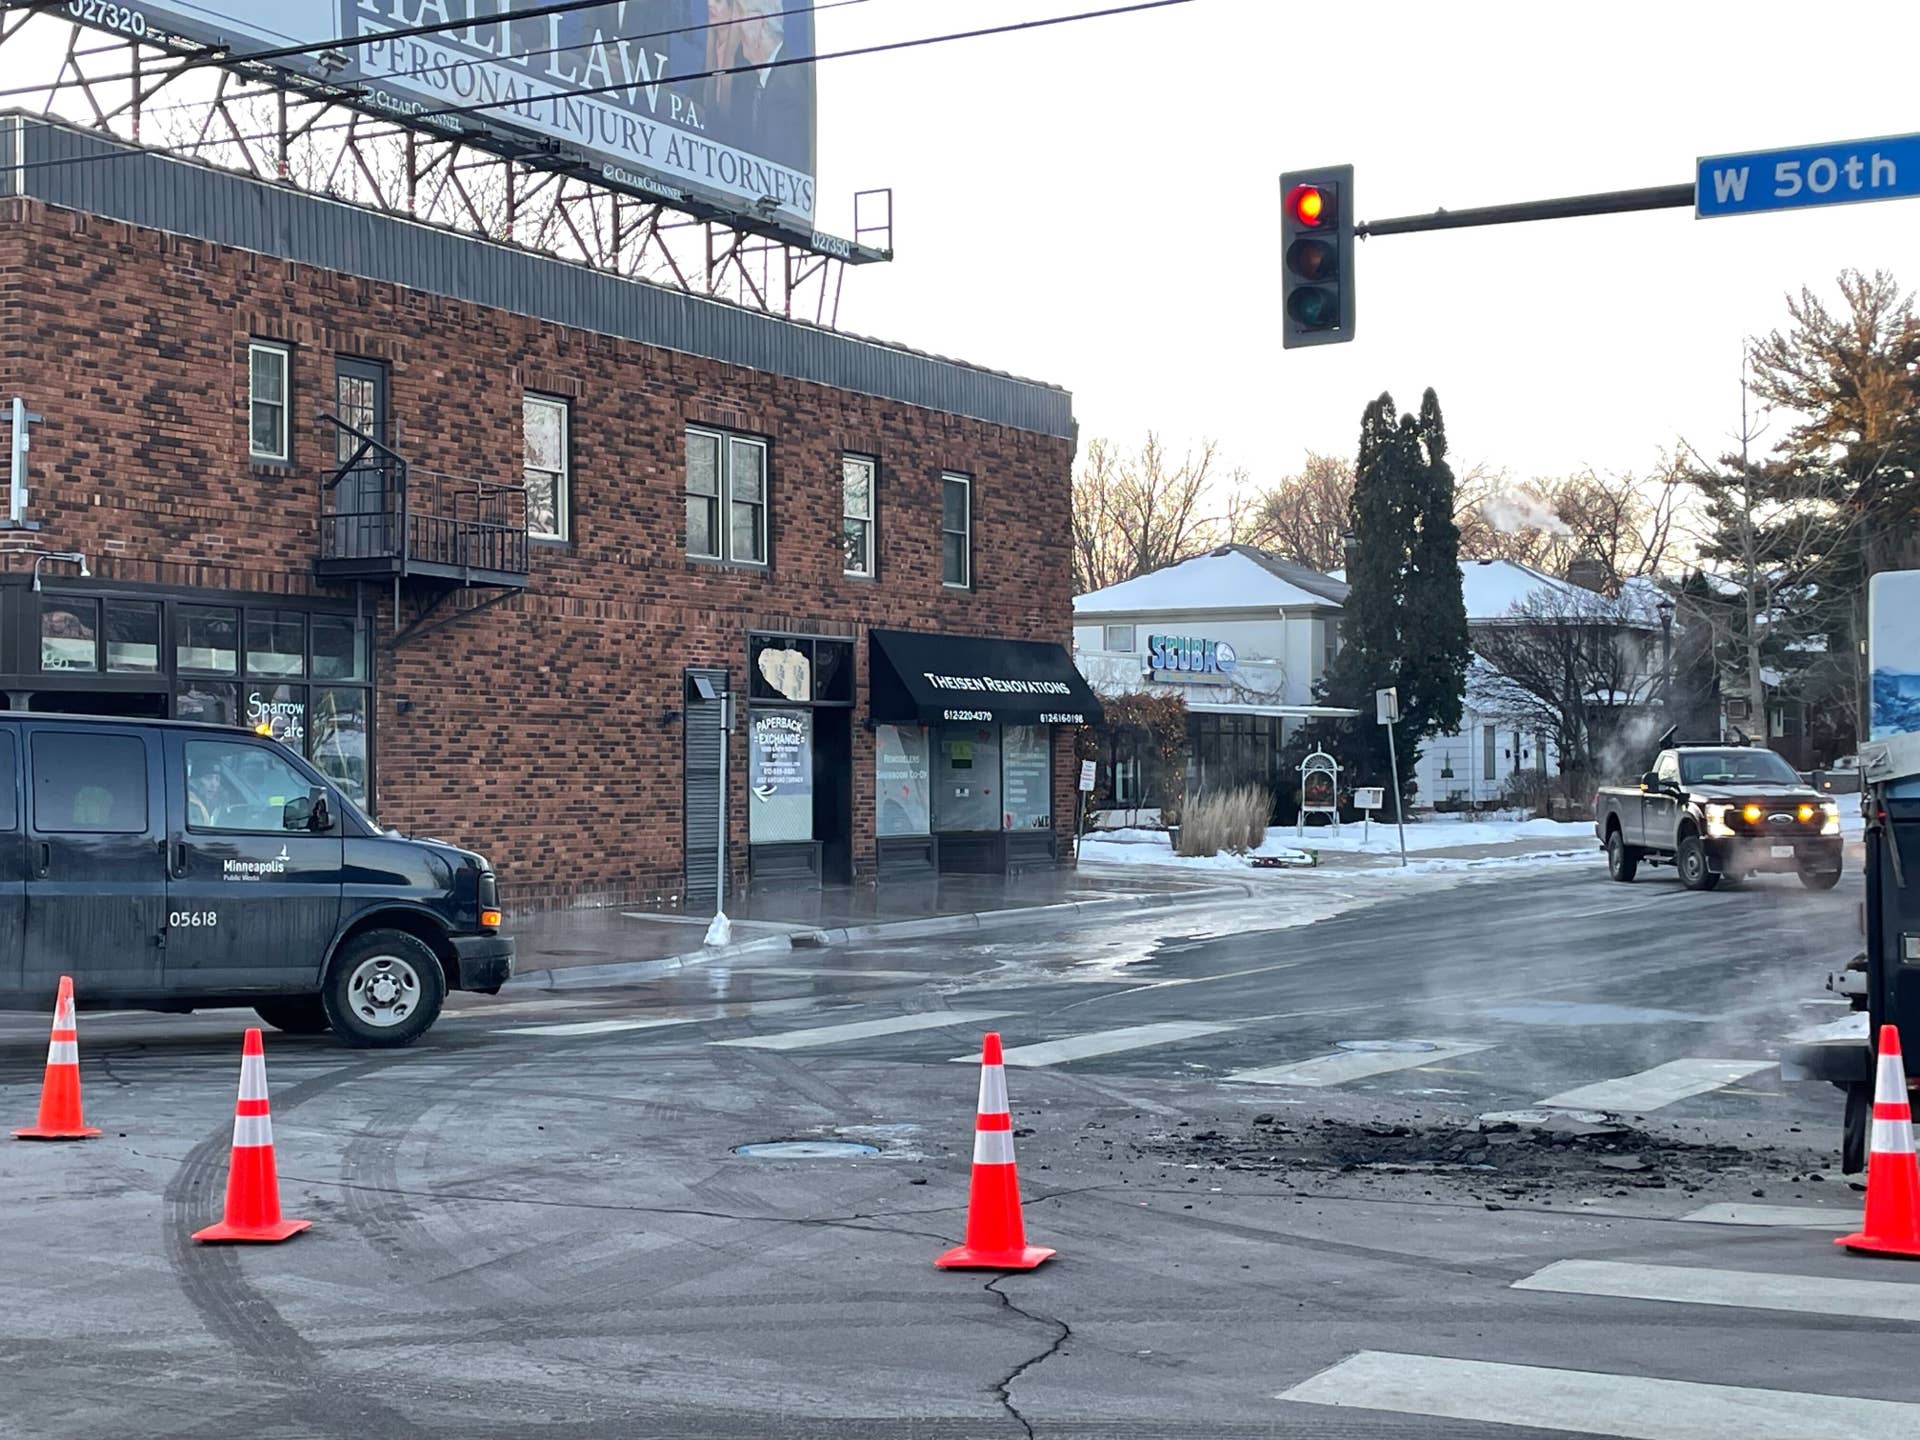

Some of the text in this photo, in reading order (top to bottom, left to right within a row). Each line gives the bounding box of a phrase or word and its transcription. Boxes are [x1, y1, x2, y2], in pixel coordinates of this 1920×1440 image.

[67, 0, 146, 37] 027320
[357, 0, 705, 130] ALL LAW P.A.
[364, 26, 812, 213] PERSONAL INJURY ATTORNEYS
[1713, 152, 1897, 204] W 50th
[811, 232, 850, 256] 027350
[1150, 635, 1217, 672] SCUBA
[924, 673, 1071, 695] THEISEN RENOVATIONS
[247, 692, 304, 723] Sparrow
[270, 716, 304, 741] Cafe
[756, 716, 803, 734] PAPERBACK
[758, 734, 801, 745] EXCHANGE
[223, 860, 284, 875] Minneapolis
[169, 911, 217, 927] 05618
